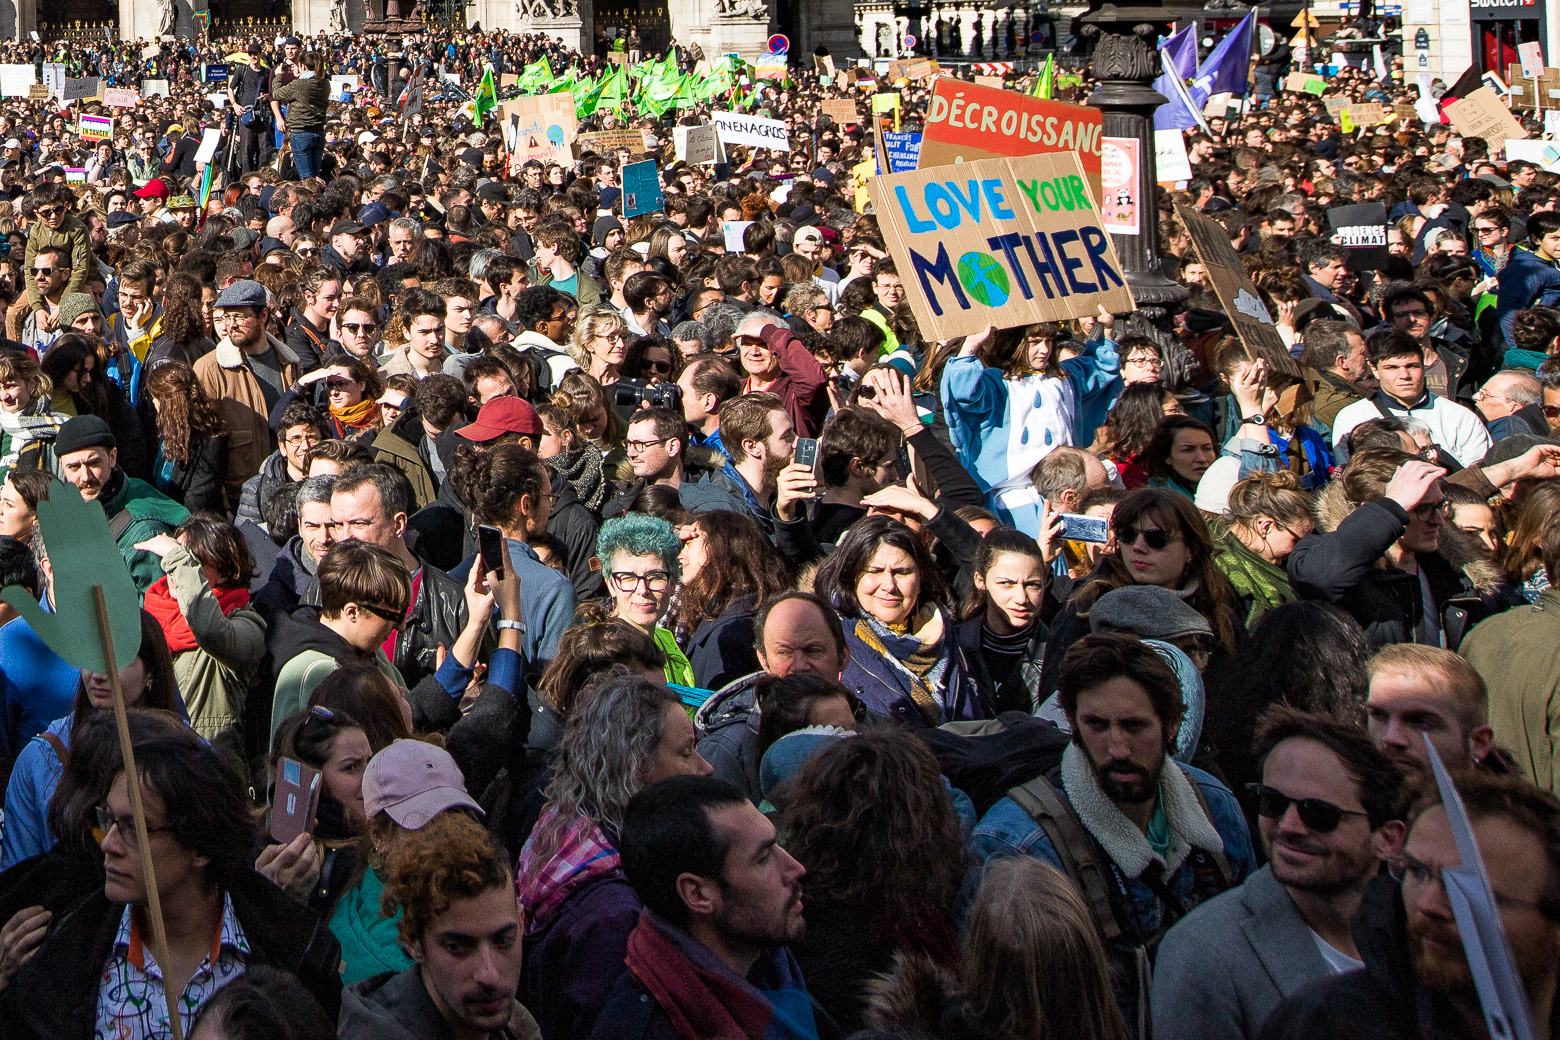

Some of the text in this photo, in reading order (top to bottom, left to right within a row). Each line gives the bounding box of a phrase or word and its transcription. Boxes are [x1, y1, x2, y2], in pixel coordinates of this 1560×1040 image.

[894, 174, 1093, 234] LOVE YOUR
[1336, 225, 1386, 236] URGENCE
[1341, 235, 1385, 245] CLIMAT
[908, 225, 1124, 316] MOTHER
